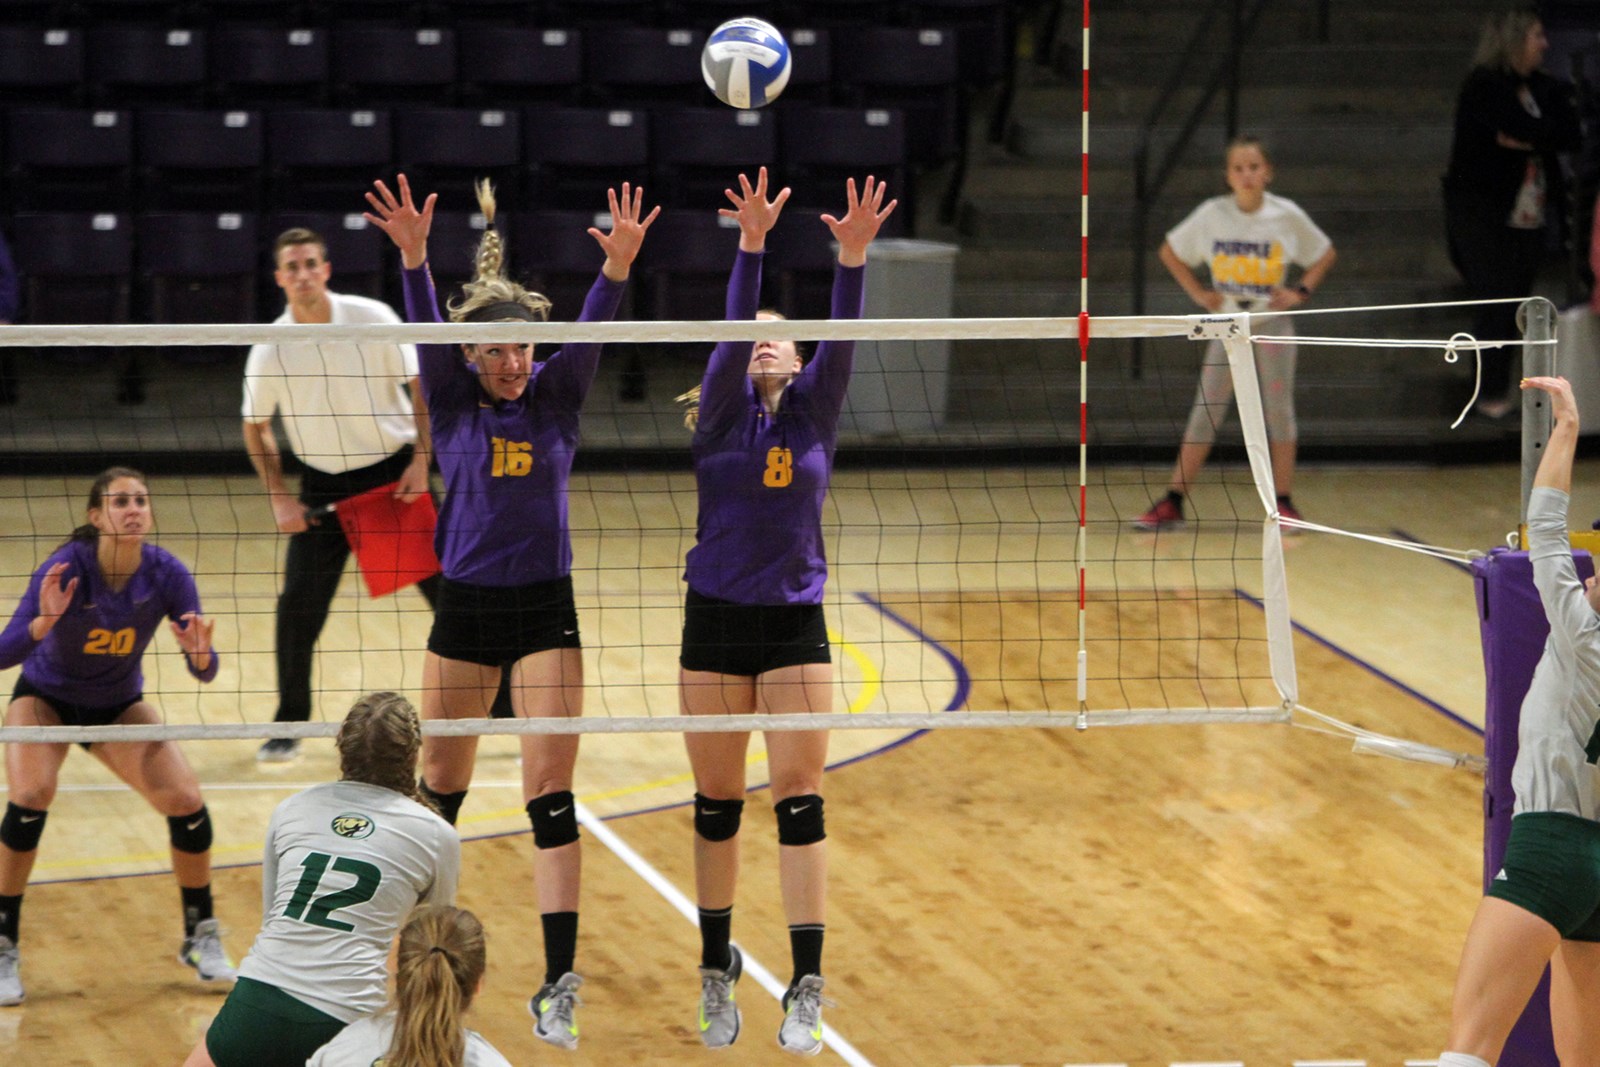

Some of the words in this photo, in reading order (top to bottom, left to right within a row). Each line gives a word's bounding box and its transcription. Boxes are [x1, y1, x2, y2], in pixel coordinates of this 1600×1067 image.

[1213, 240, 1270, 259] PURPLE
[491, 437, 533, 477] 16
[763, 446, 793, 487] 8
[83, 627, 136, 656] 20
[281, 851, 382, 933] 12
